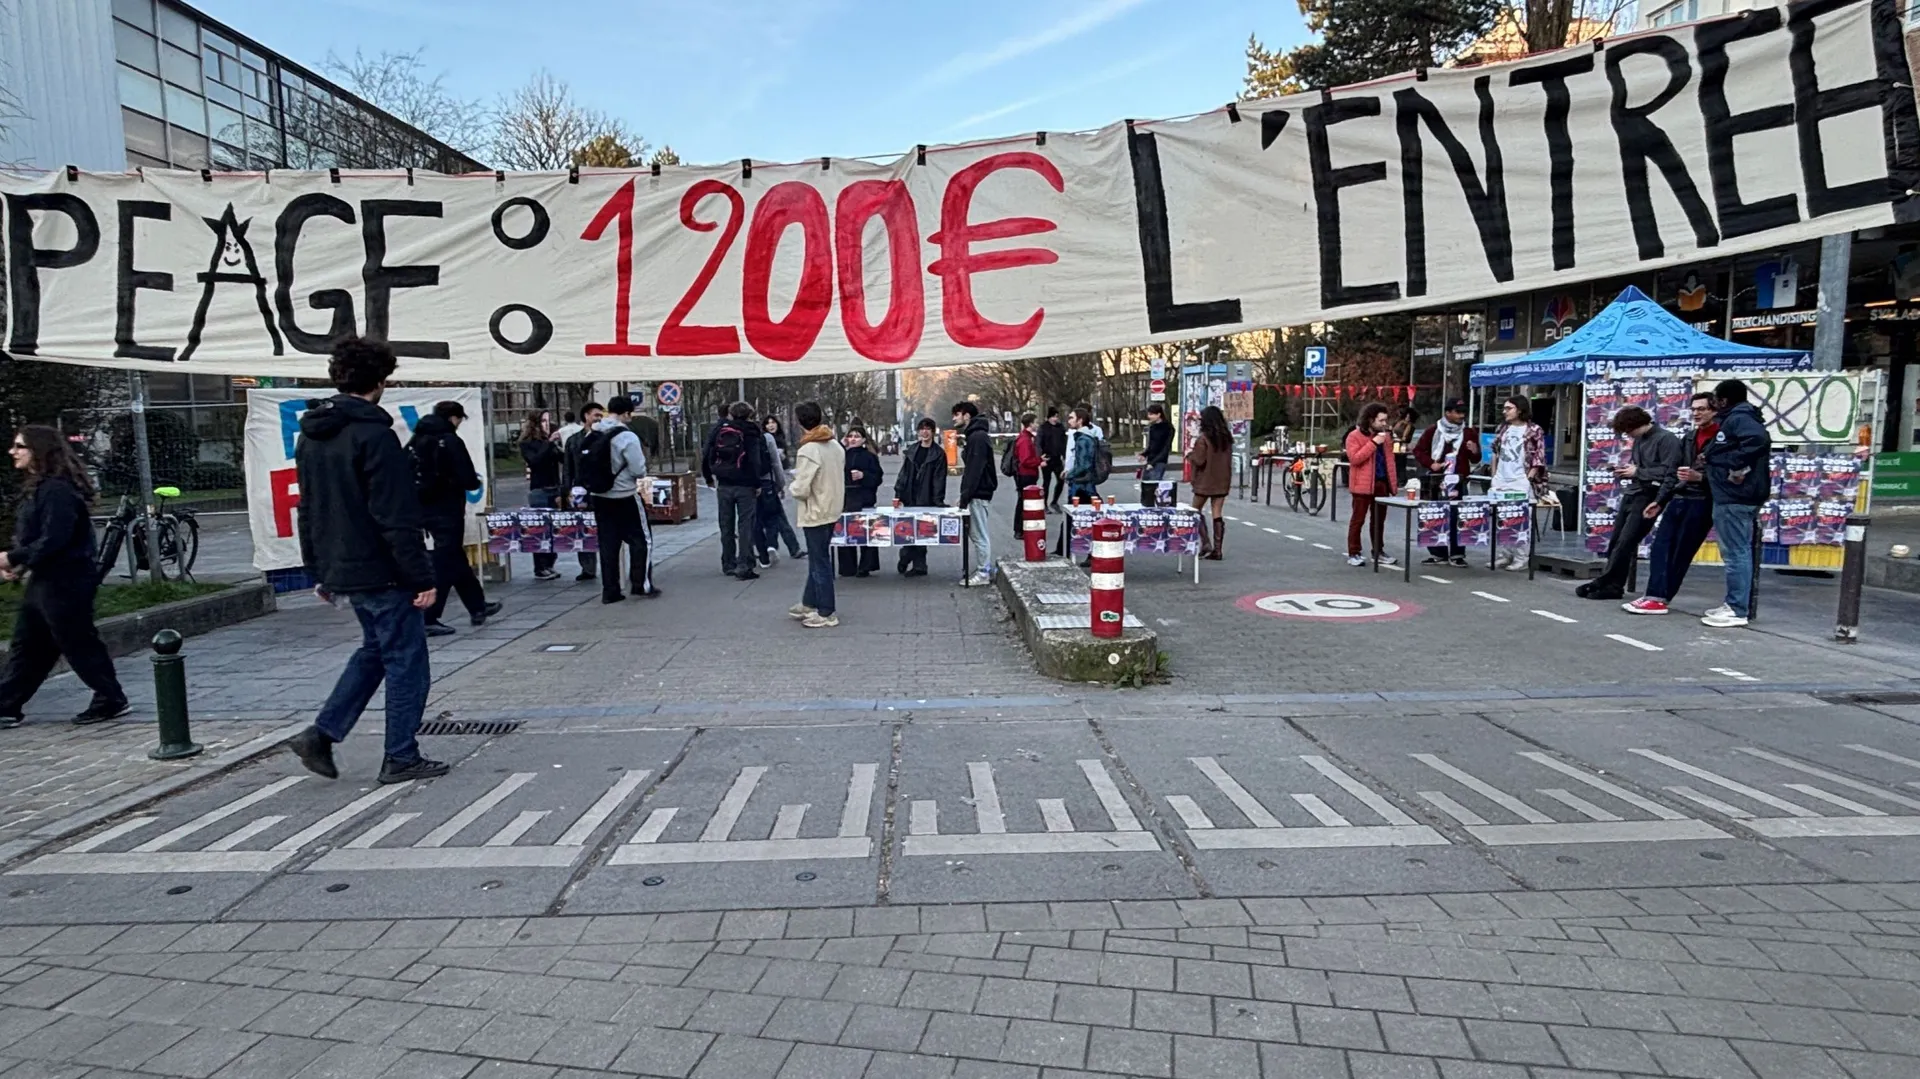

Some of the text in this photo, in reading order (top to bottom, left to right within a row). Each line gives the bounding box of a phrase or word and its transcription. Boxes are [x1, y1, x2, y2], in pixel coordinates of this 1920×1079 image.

[3, 191, 450, 361] PEAGE
[580, 151, 1065, 363] 1200€
[1306, 350, 1321, 369] P
[1274, 599, 1375, 612] 10
